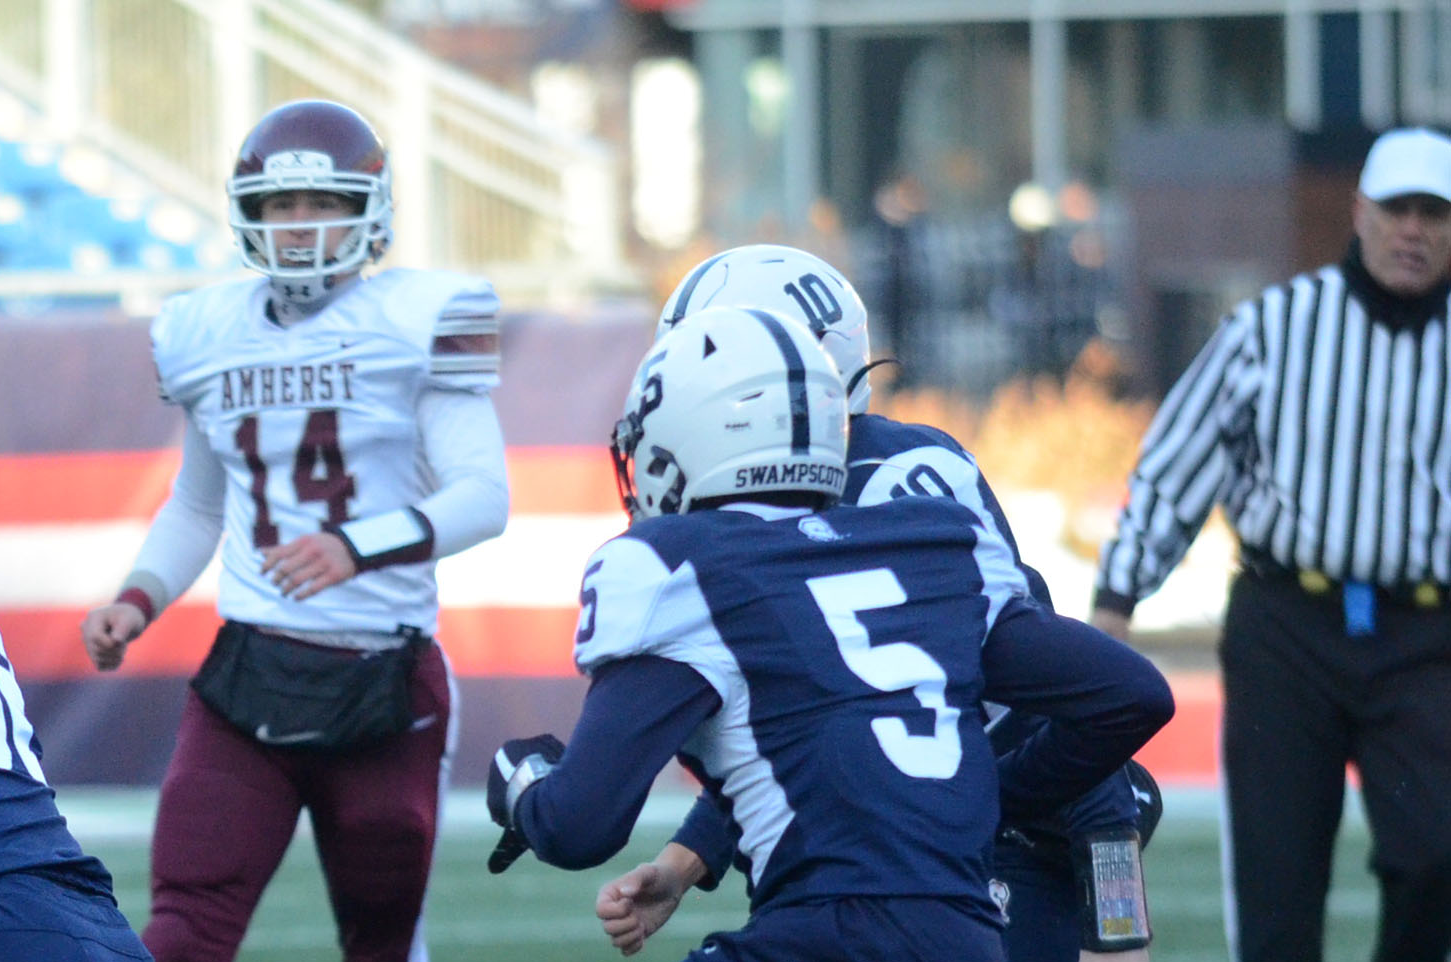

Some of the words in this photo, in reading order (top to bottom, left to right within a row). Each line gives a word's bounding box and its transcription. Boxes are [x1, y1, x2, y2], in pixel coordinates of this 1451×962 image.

[784, 273, 843, 331] 10
[222, 363, 356, 411] AMHERST
[234, 408, 357, 549] 14
[806, 567, 963, 780] 5
